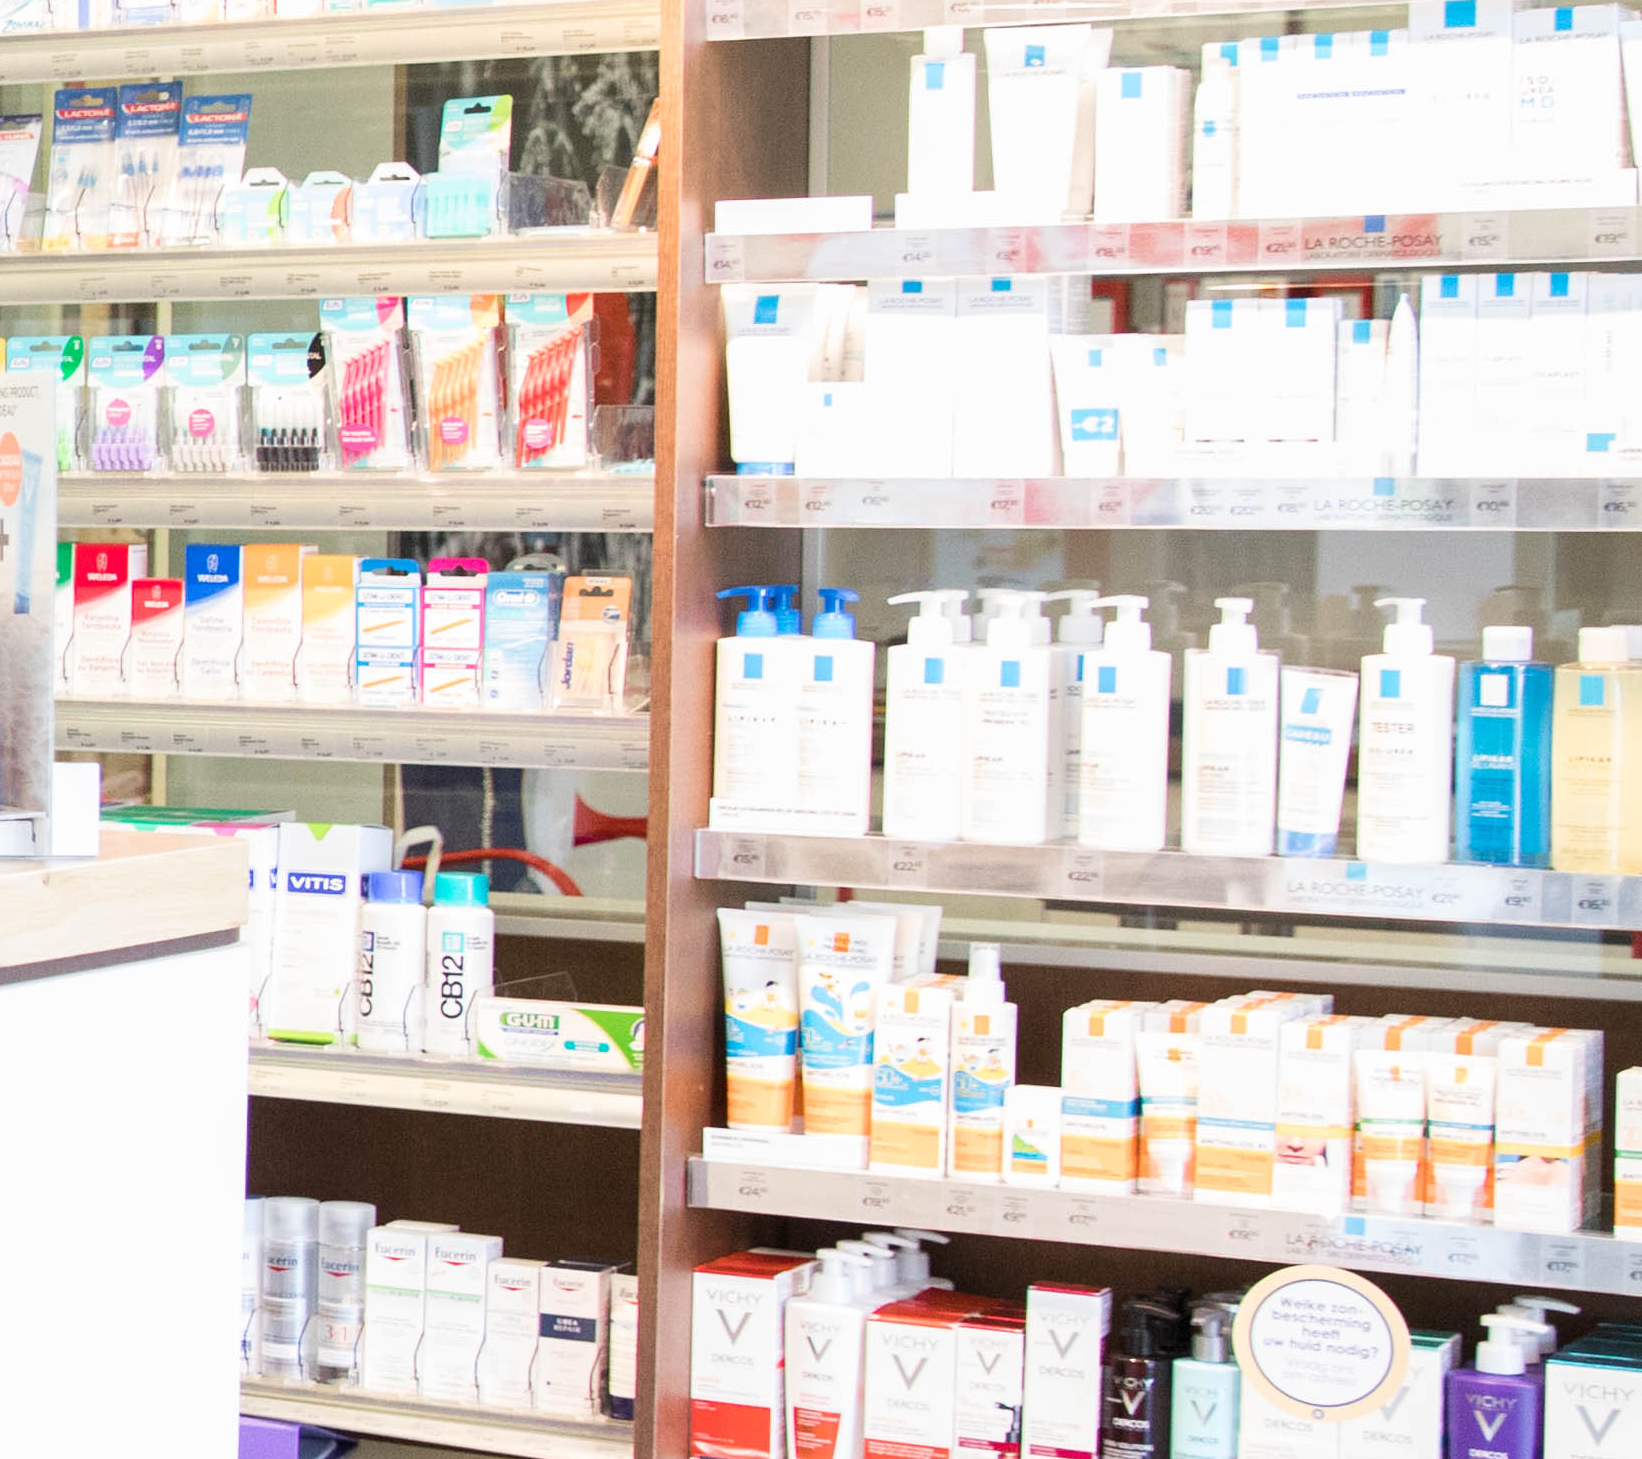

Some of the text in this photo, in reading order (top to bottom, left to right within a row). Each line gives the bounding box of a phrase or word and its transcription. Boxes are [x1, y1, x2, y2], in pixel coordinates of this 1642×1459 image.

[1304, 233, 1444, 251] LA ROCHE-POSAY
[1314, 497, 1454, 512] LA ROCHE-POSAY
[561, 640, 575, 689] Jordan
[291, 876, 344, 892] VITIS
[1286, 880, 1424, 900] LA ROCHE-POSAY
[360, 953, 375, 1018] CB12
[441, 955, 464, 1020] CB12
[374, 1242, 416, 1257] Eucerin
[435, 1246, 476, 1262] Eucerin
[494, 1274, 530, 1288] Eucerin
[706, 1288, 763, 1307] VICHY
[1279, 1296, 1364, 1316] Welke zon-
[799, 1319, 842, 1335] VICHY
[1038, 1311, 1090, 1327] VICHY
[1271, 1309, 1372, 1333] bescherming
[1300, 1324, 1341, 1341] heeft
[881, 1333, 939, 1352] VICHY
[1263, 1335, 1380, 1361] uw huid nodig?
[711, 1353, 754, 1367] DERCOS
[803, 1371, 834, 1383] DERCOS
[1038, 1365, 1085, 1380] DERCOS
[1562, 1380, 1637, 1404] VICHY
[887, 1398, 931, 1413] DERCOS
[1466, 1393, 1518, 1410] VICHY
[1264, 1417, 1314, 1433] DERCOS
[1362, 1429, 1413, 1446] DERCOS
